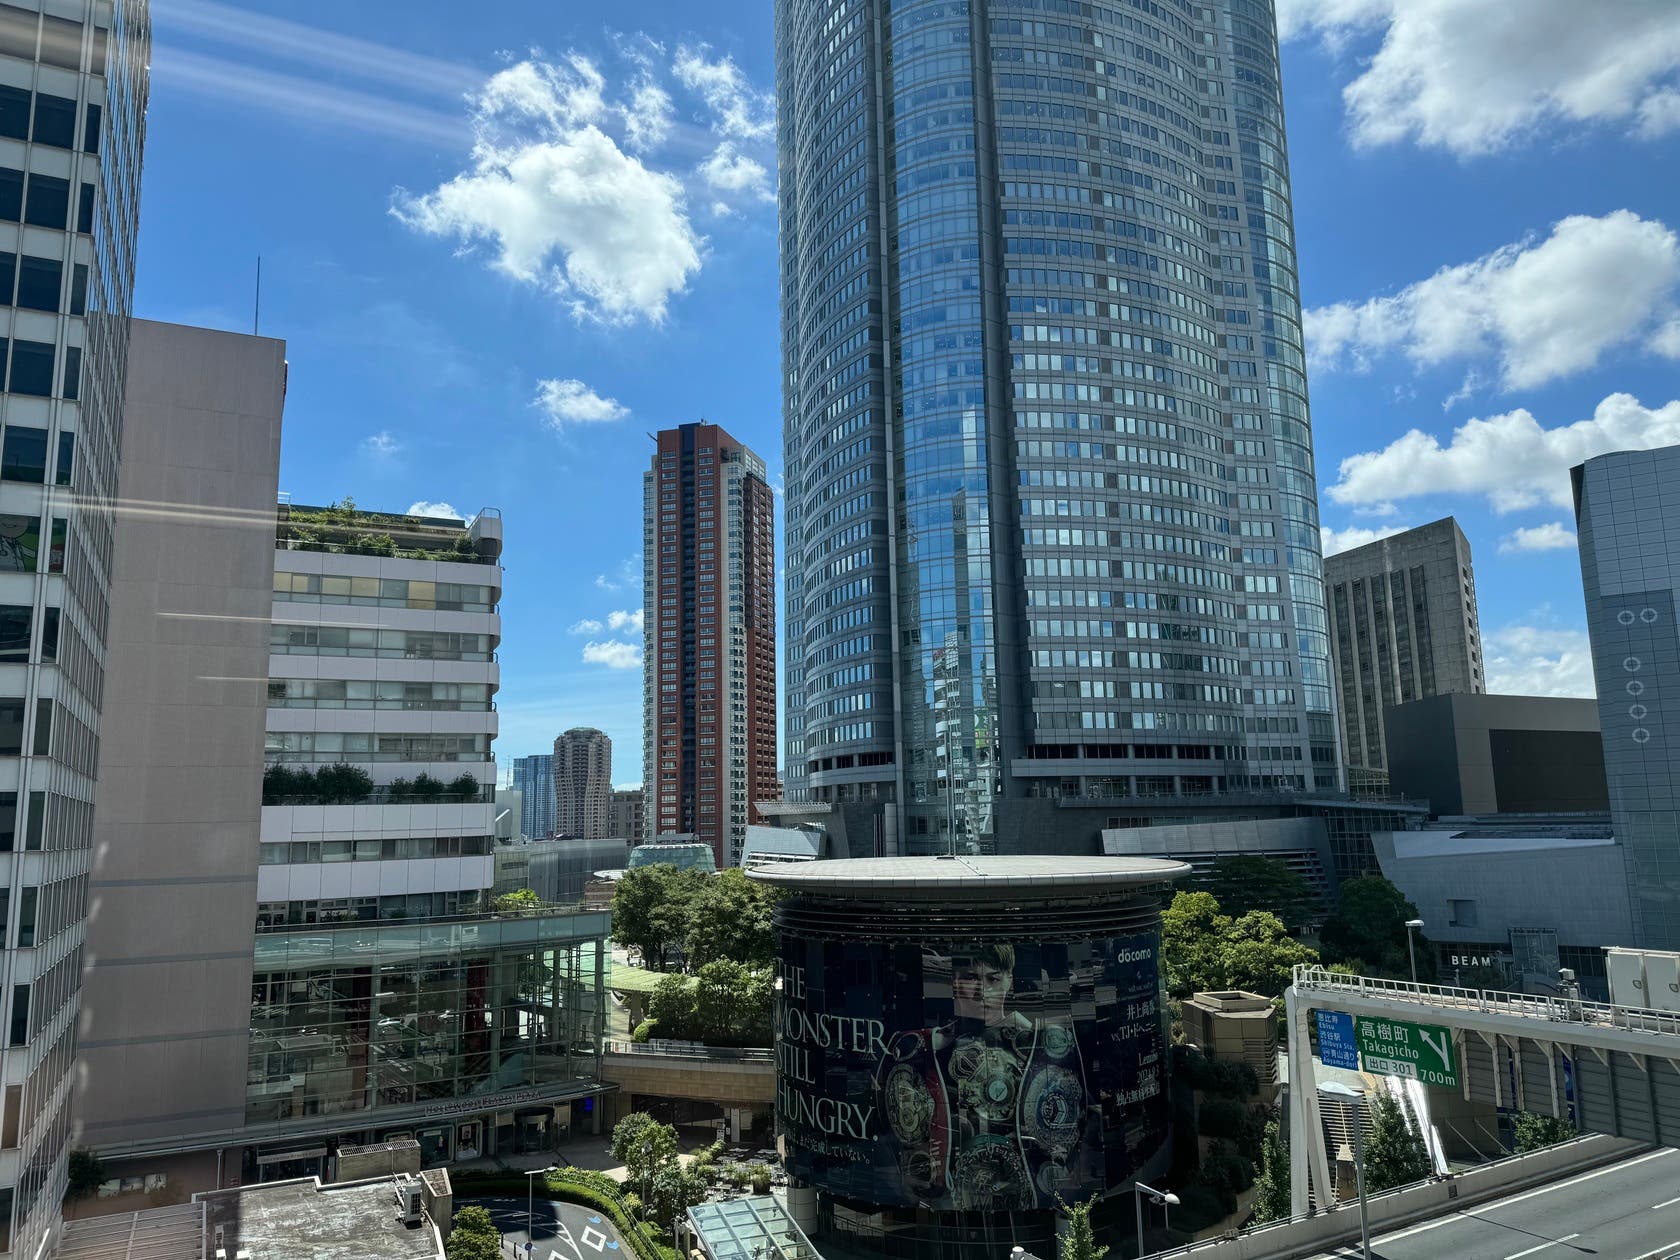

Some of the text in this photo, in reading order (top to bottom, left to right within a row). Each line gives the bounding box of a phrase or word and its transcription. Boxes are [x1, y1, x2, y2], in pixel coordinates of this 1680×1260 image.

[1118, 948, 1151, 964] docomo
[1451, 955, 1491, 967] BEAM
[773, 1000, 893, 1056] MONSTER
[1360, 1020, 1409, 1044] 高樹町
[1363, 1040, 1419, 1060] Takagicho
[777, 1042, 816, 1085] STILL
[1369, 1059, 1413, 1076] 出口 301
[1420, 1069, 1456, 1087] 700m
[778, 1075, 879, 1142] HUNGRY.
